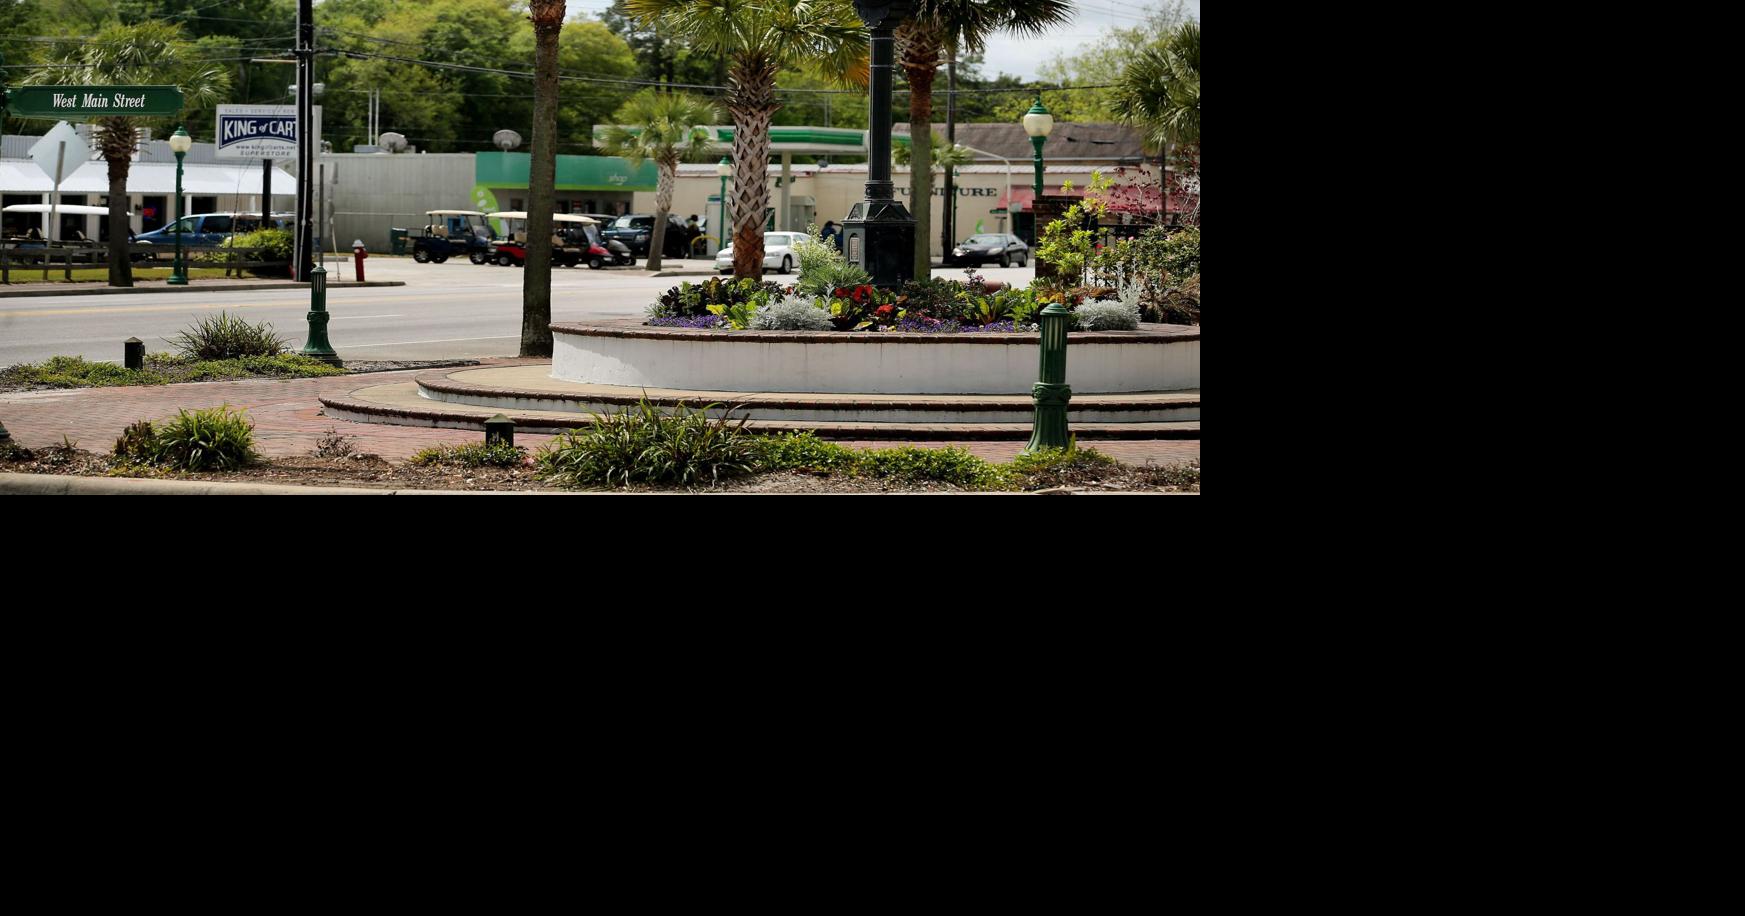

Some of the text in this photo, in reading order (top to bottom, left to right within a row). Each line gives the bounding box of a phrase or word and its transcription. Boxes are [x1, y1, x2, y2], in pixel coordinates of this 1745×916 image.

[53, 92, 146, 108] West Main Street
[224, 120, 296, 140] KING of CART
[893, 187, 997, 197] UNIURE
